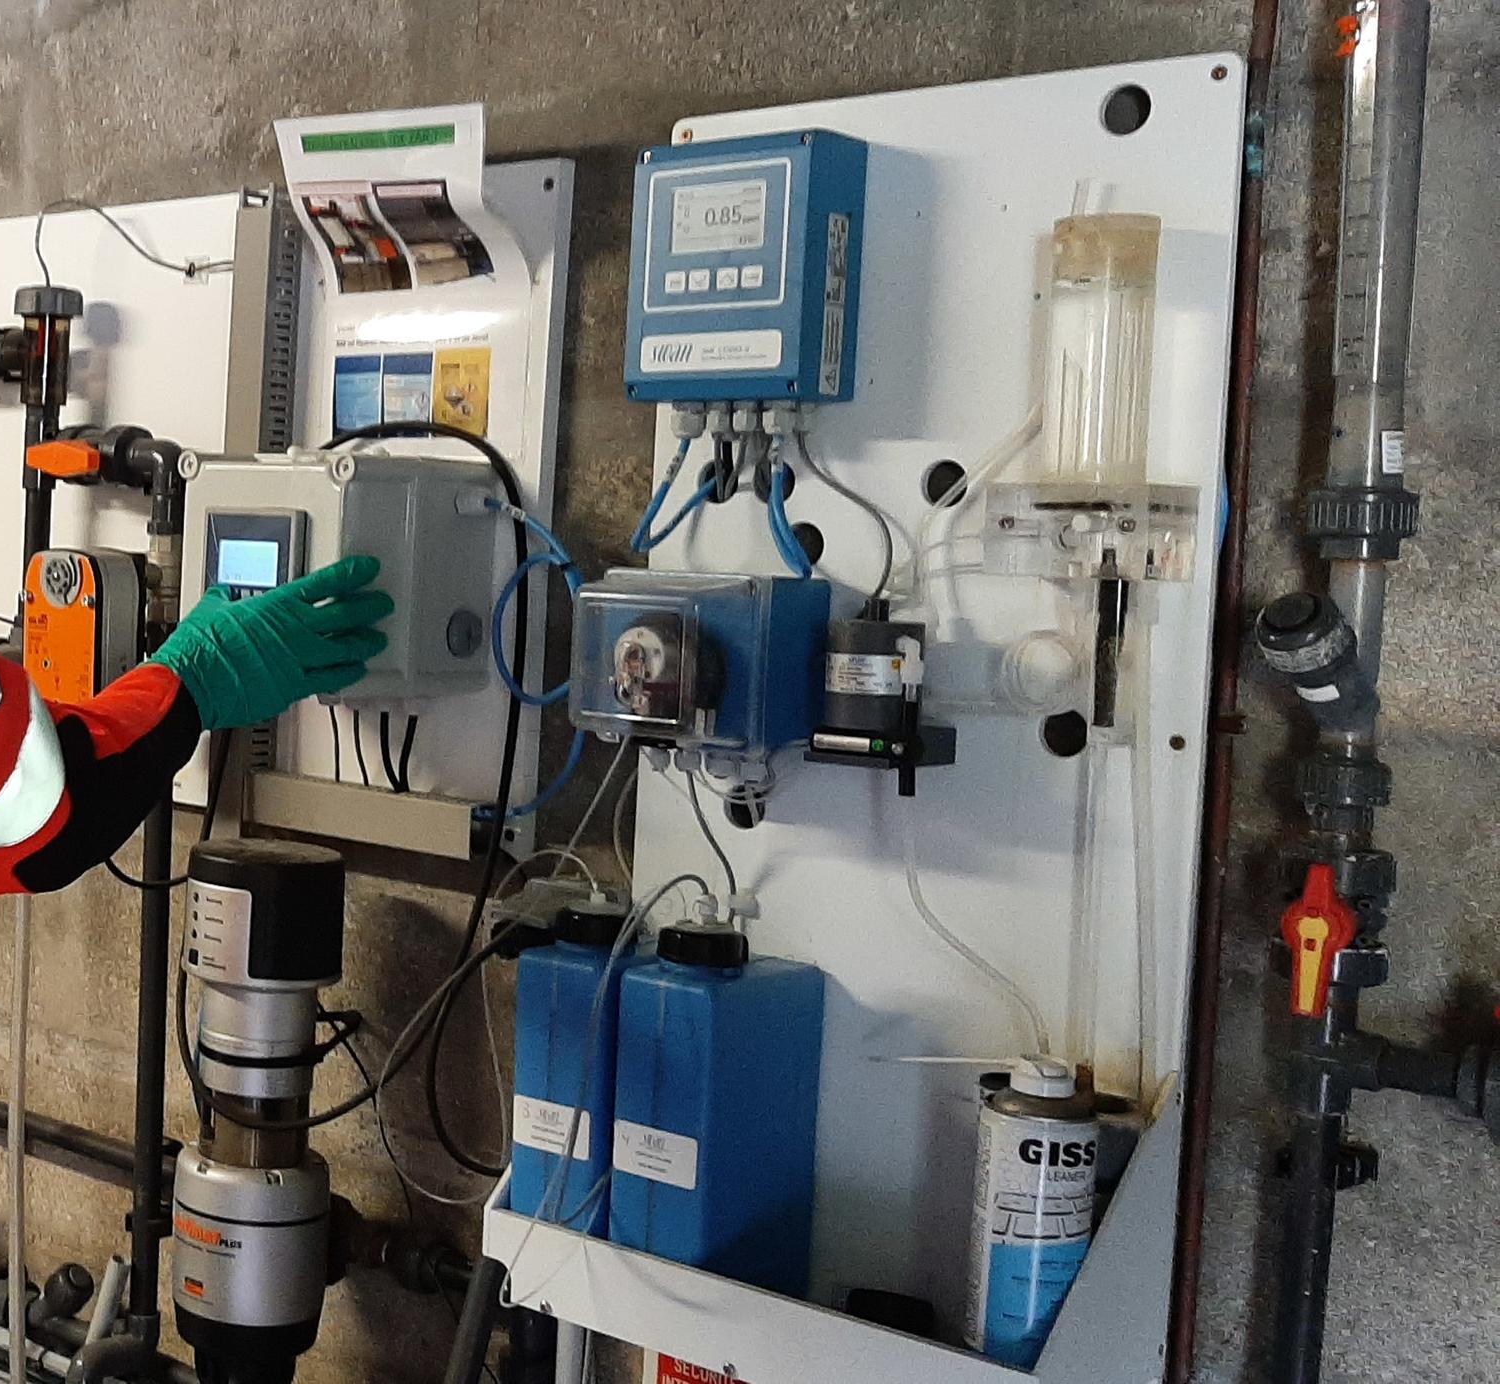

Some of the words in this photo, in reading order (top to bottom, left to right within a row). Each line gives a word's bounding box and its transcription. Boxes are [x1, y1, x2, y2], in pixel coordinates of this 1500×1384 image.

[705, 205, 742, 227] 0.85
[1019, 1138, 1097, 1168] GISS
[1043, 1170, 1087, 1182] LEANER
